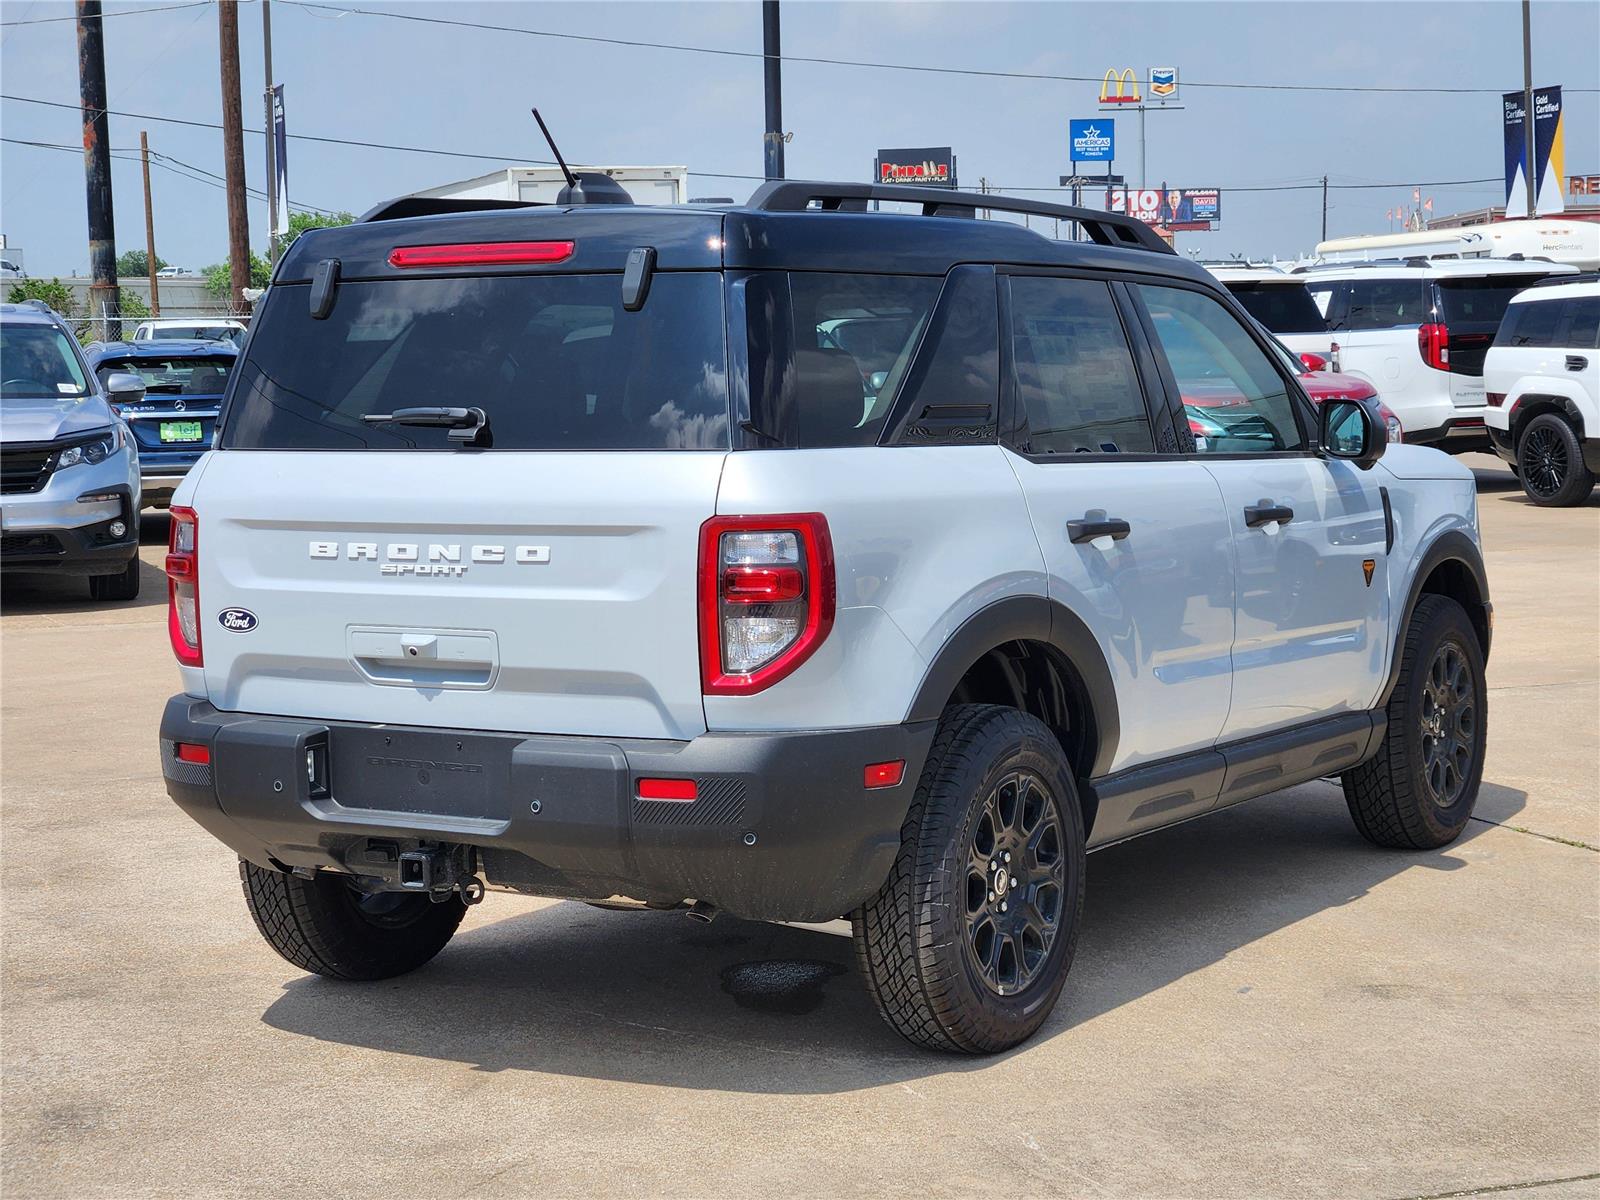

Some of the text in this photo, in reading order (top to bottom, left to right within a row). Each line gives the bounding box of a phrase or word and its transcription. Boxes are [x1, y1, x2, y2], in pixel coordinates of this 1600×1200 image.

[1505, 101, 1517, 110] Blue
[1536, 94, 1548, 105] Gold
[1536, 102, 1559, 114] Certified
[1112, 190, 1160, 212] 210
[308, 541, 551, 564] BRONCO
[380, 563, 468, 577] SPORT
[223, 610, 250, 630] Ford
